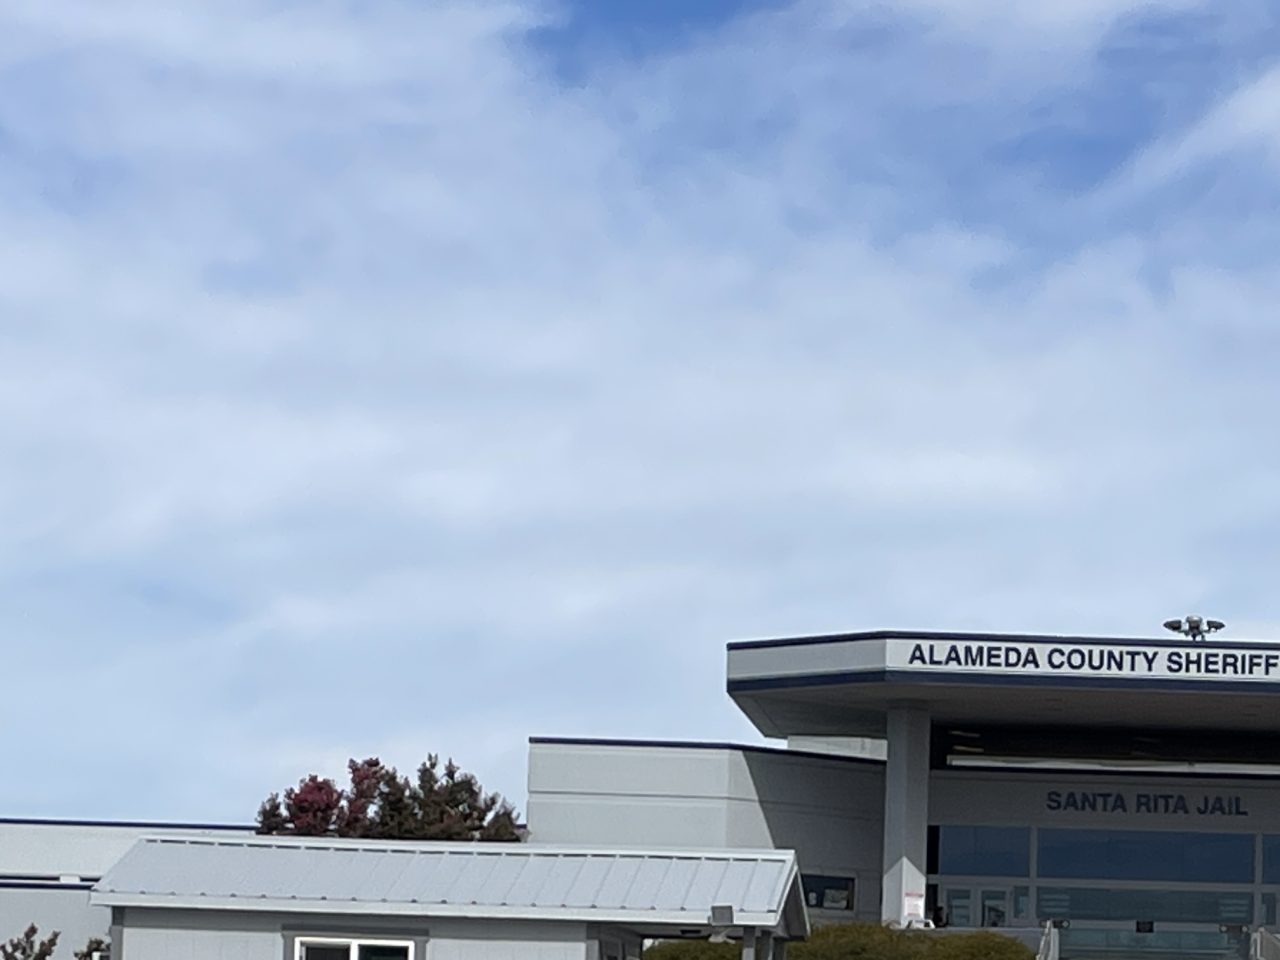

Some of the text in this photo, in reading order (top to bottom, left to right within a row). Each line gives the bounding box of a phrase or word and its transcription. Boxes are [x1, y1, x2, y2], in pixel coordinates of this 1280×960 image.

[908, 643, 1041, 670] ALAMEDA
[1047, 647, 1159, 673] COUNTY
[1046, 790, 1249, 817] SANTA RITA JAIL
